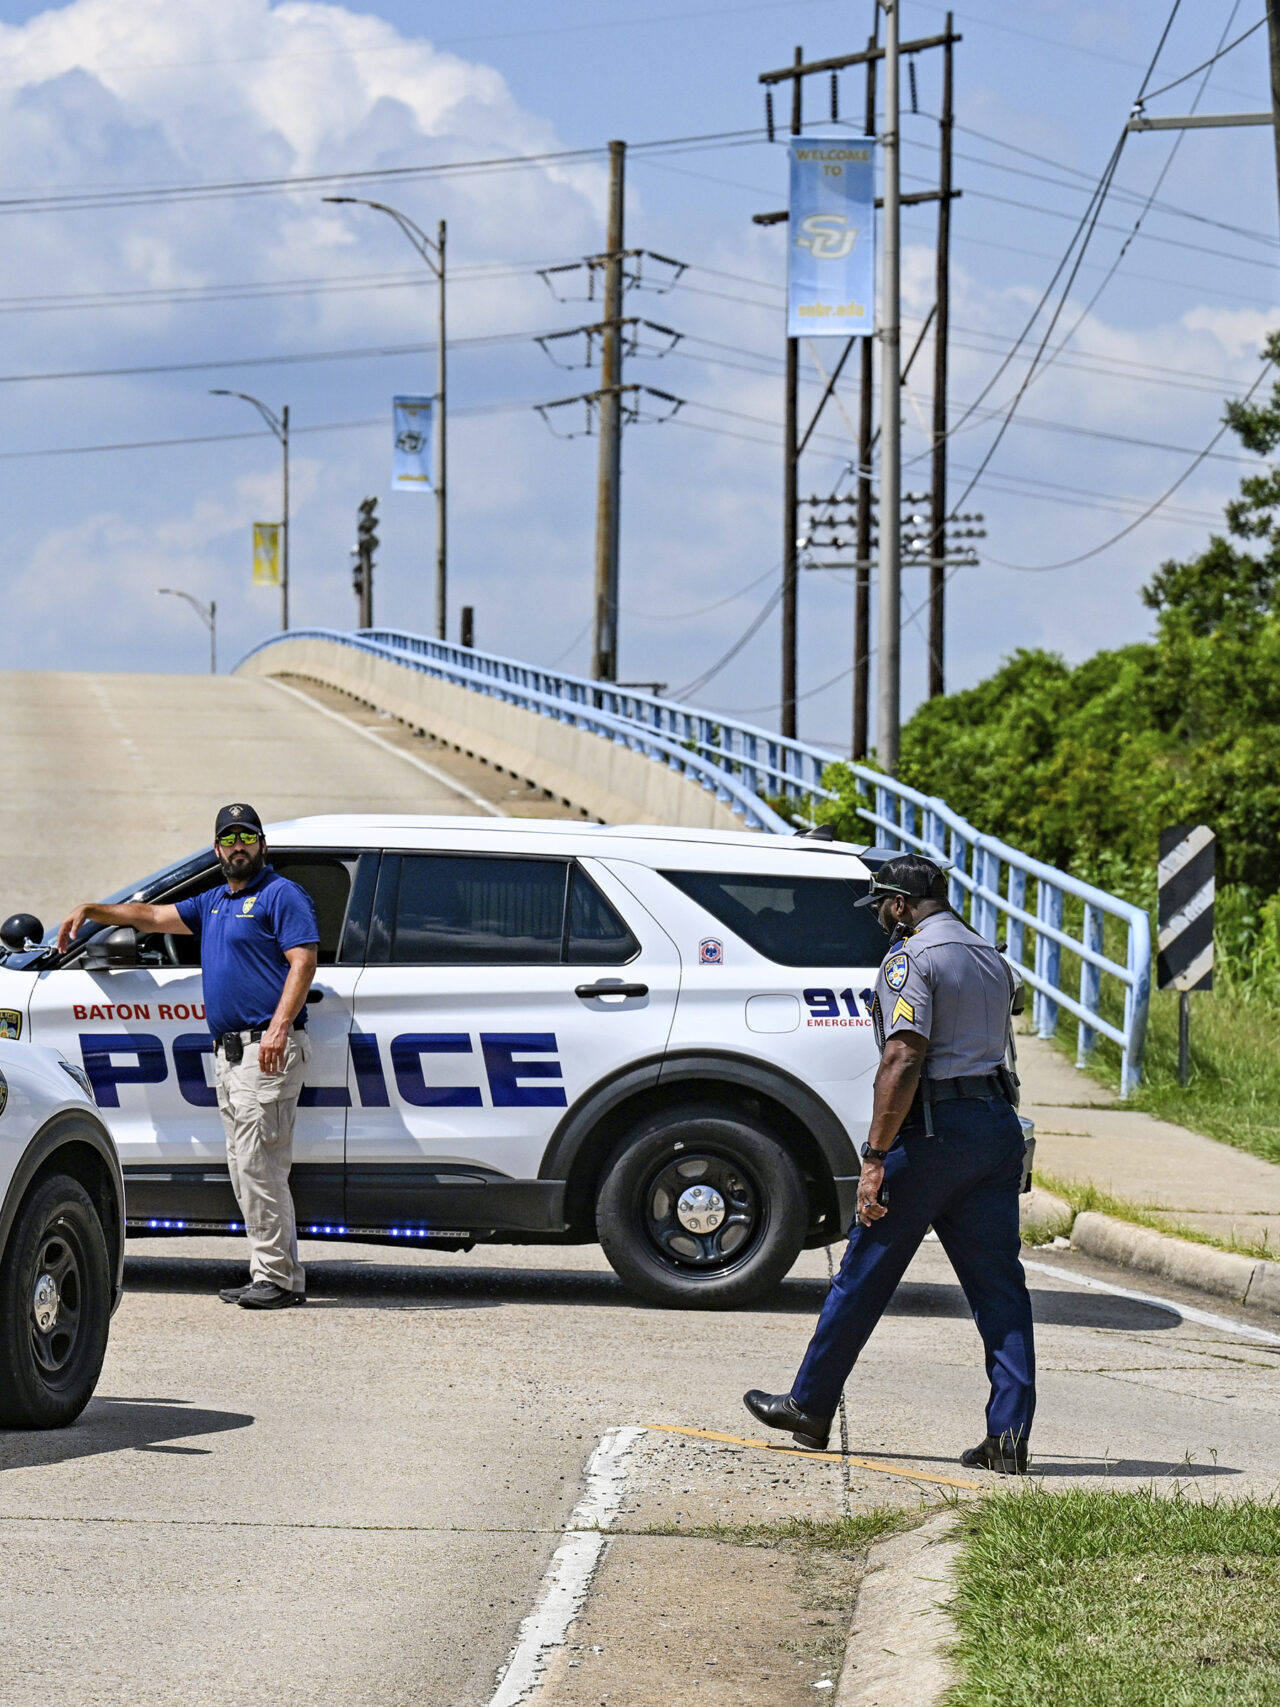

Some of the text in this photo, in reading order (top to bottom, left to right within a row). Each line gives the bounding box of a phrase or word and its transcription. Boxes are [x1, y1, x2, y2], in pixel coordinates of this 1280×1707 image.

[796, 149, 869, 161] WELCOME
[823, 165, 842, 176] TO
[73, 1004, 207, 1020] BATON ROU
